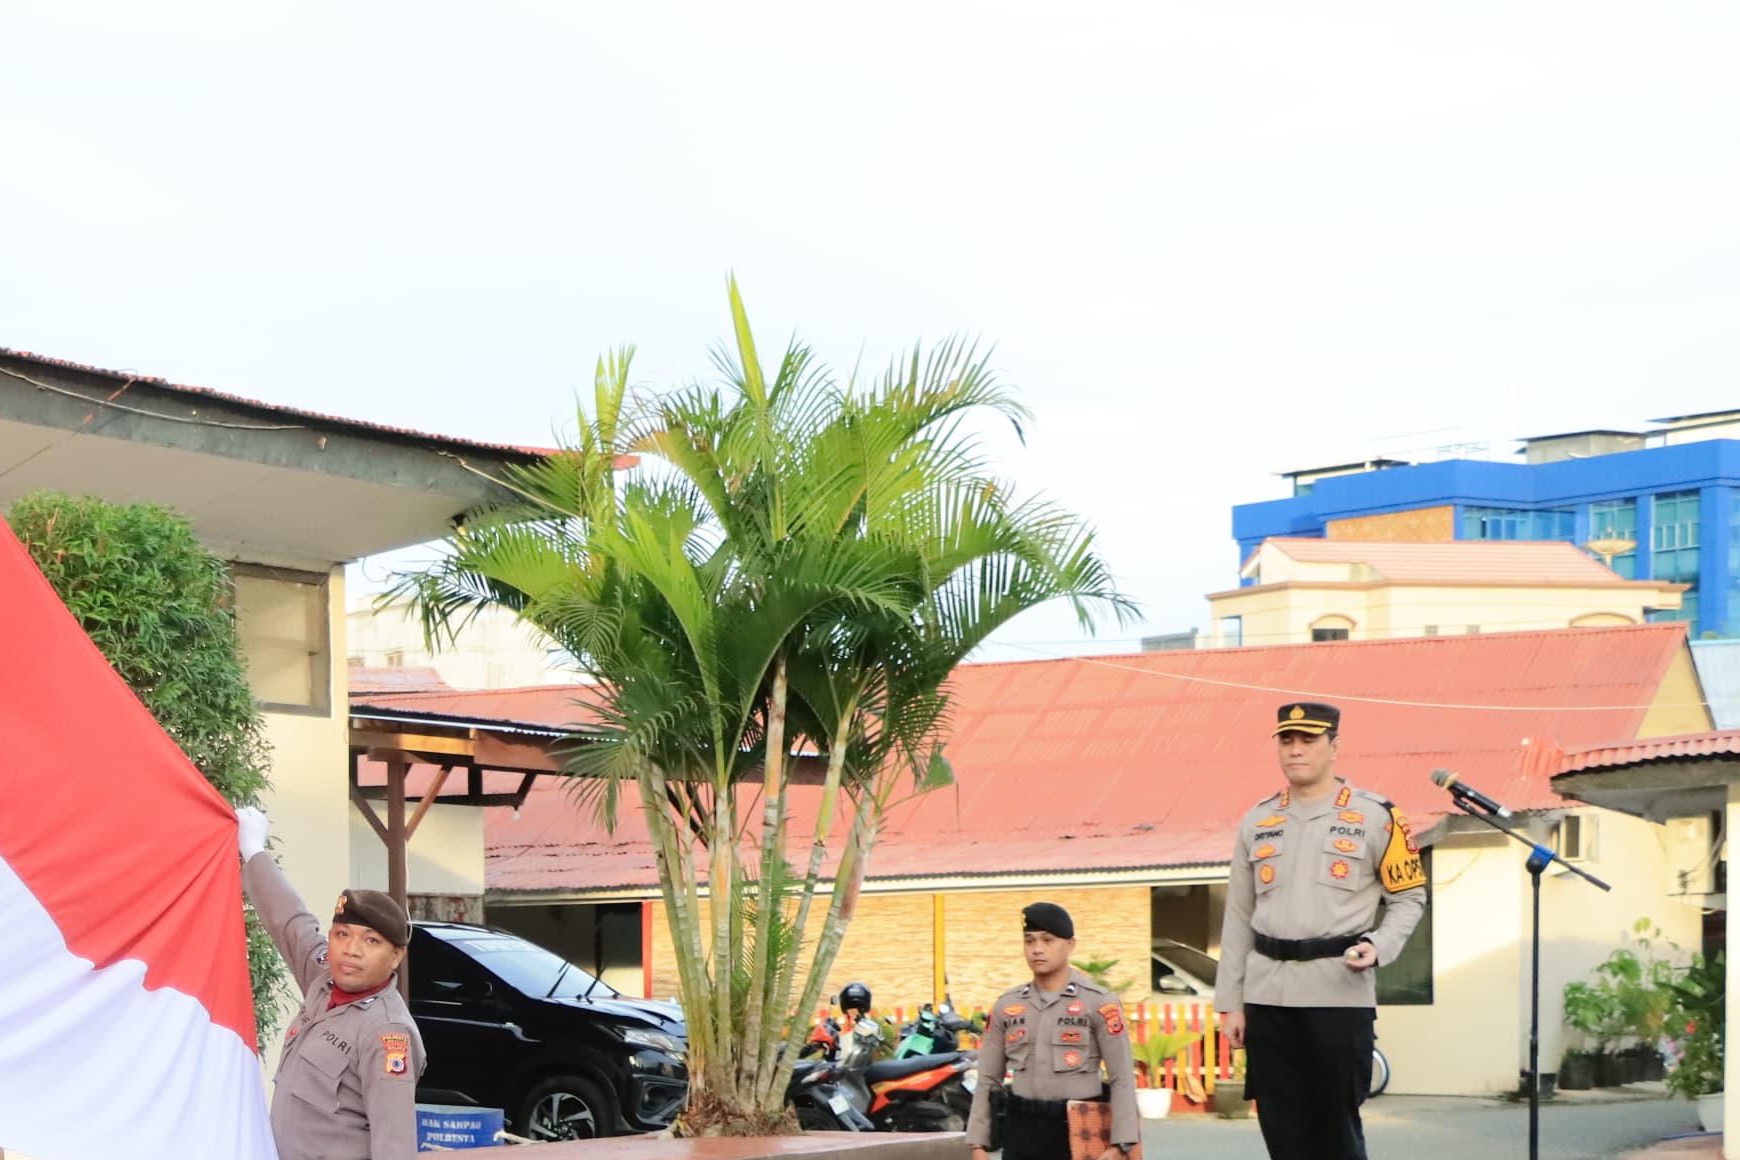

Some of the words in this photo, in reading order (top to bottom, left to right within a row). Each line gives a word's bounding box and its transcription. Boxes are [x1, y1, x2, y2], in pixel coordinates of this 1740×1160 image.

[1329, 826, 1365, 838] POLRI
[1386, 864, 1405, 885] KA
[1057, 1017, 1088, 1026] POLRI
[321, 1030, 352, 1055] POLRI
[443, 1119, 482, 1130] SAMPAH
[426, 1131, 475, 1143] POLRESTA
